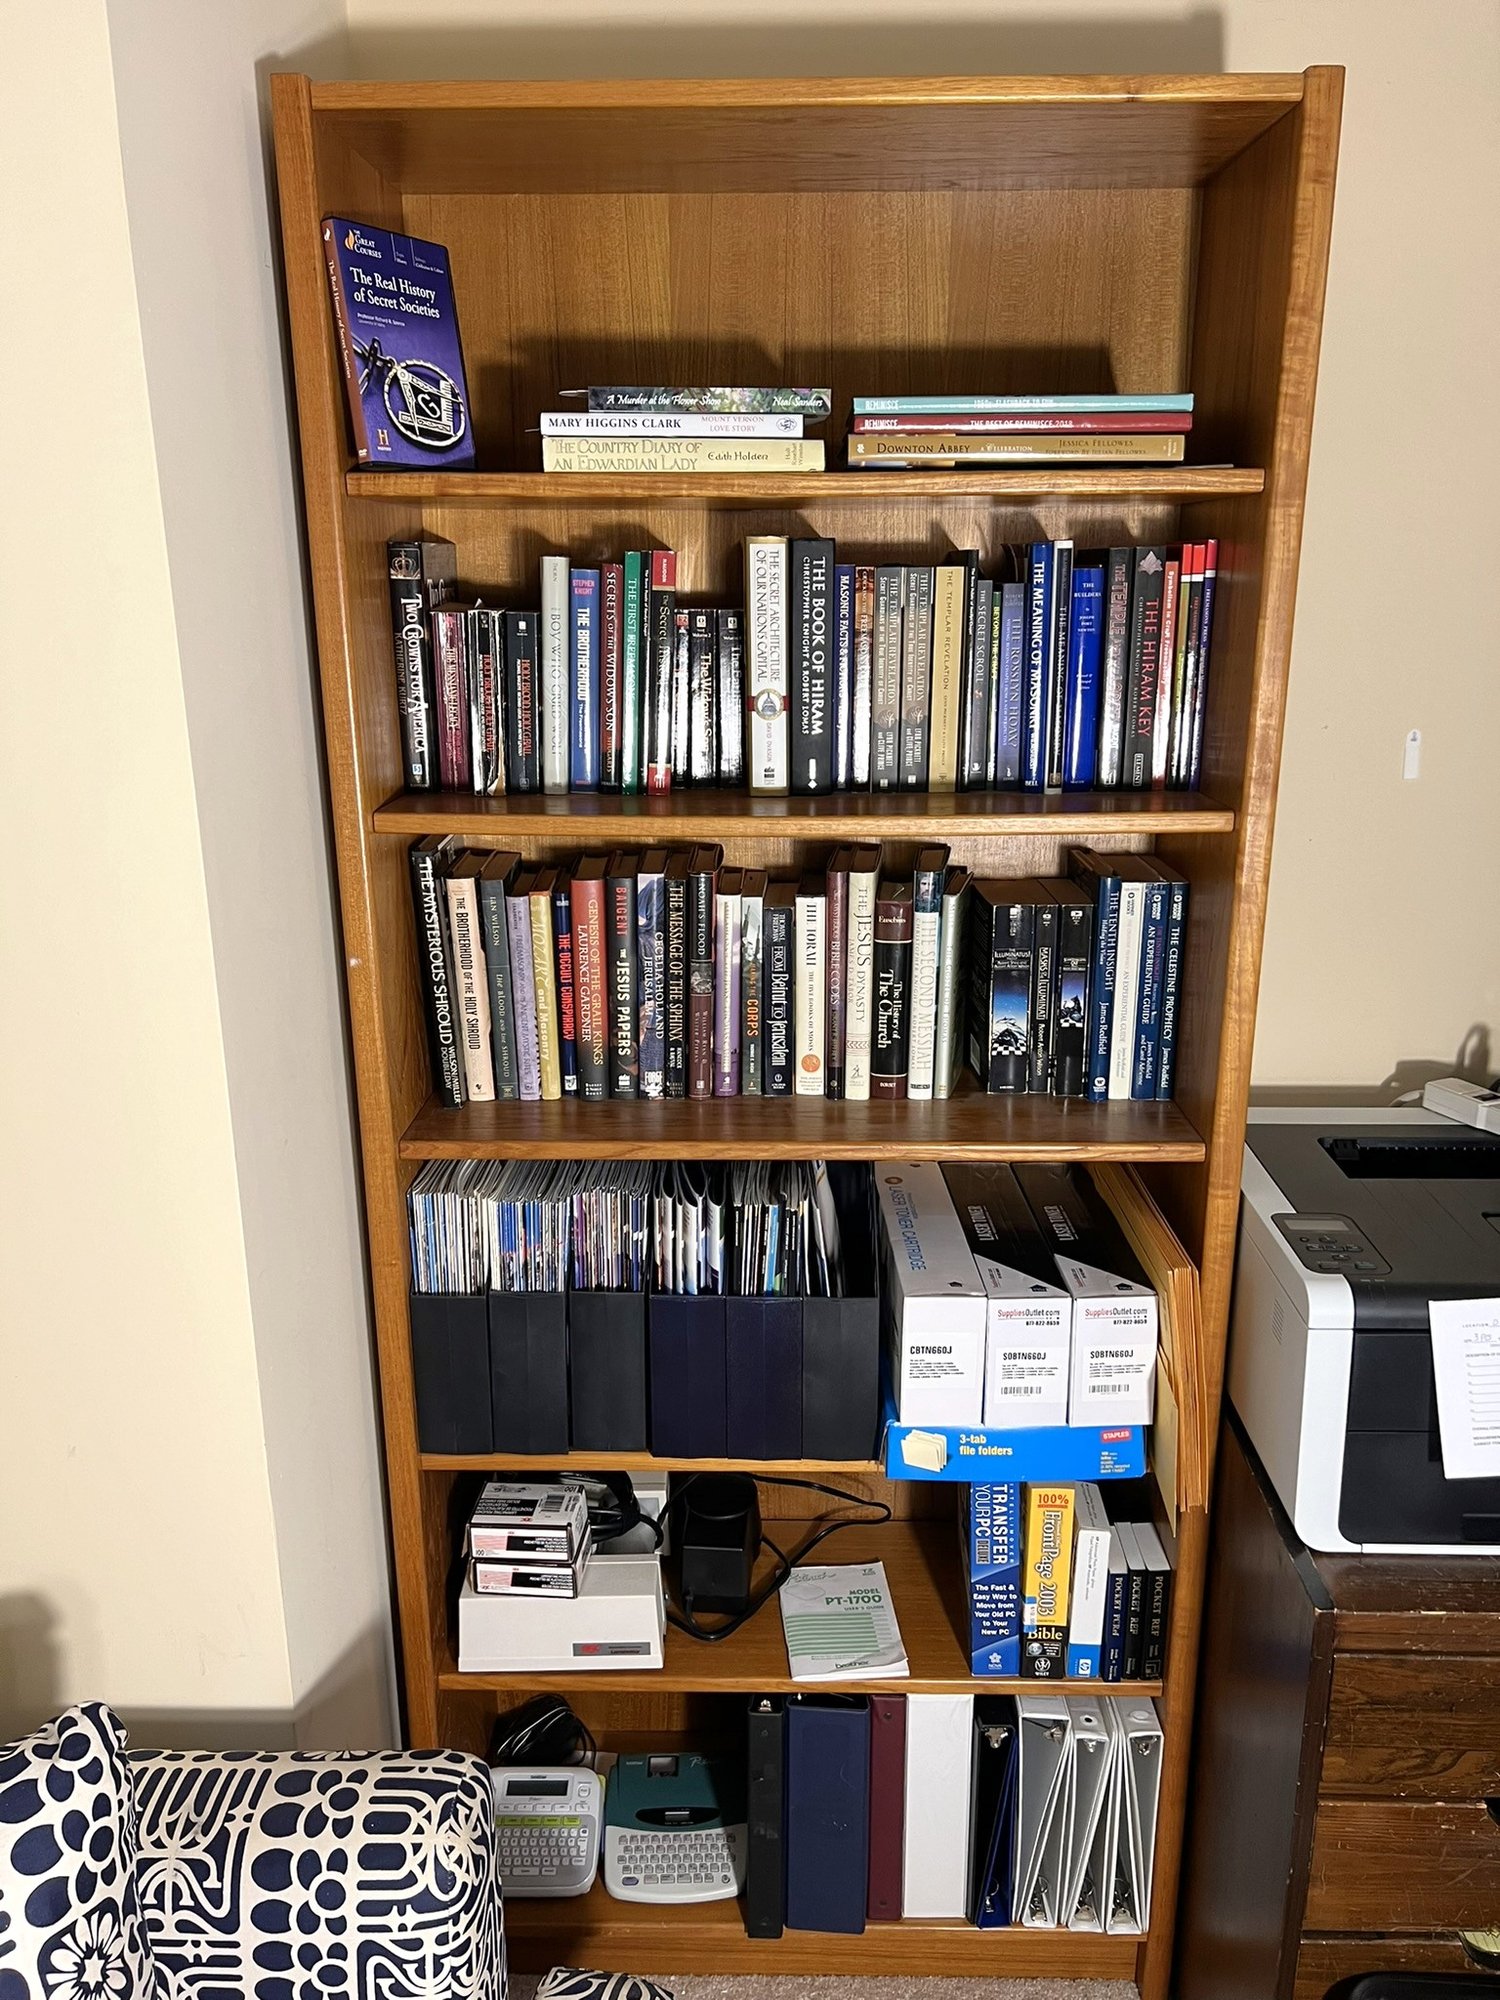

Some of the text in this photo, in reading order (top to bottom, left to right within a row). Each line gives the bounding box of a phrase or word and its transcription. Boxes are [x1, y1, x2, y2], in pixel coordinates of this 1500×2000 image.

[354, 244, 382, 259] COURSES
[355, 236, 375, 248] GREAT
[350, 267, 435, 303] The Real History
[354, 288, 440, 319] of Secret Societies
[549, 418, 682, 428] MARY HIGGINS CLARK
[865, 400, 899, 410] REMINISCE
[552, 439, 702, 454] THE COUNTRY DIARY OF
[552, 456, 697, 470] AN EDWARDIAN LADY
[708, 452, 768, 461] Edith Holden
[877, 442, 970, 454] DOWNTON ABBEY
[1059, 439, 1133, 447] JESSICA FELLOWES
[802, 556, 810, 620] CHRISTOPHER
[756, 550, 767, 682] OF OUR NATION'S CAPITAL
[769, 550, 780, 682] THE SECRET ARCHITECTURE
[977, 605, 986, 642] SECRET
[802, 623, 810, 658] KNIGHT
[811, 556, 825, 735] THE BOOK OF HIRAM
[887, 577, 898, 705] THE TEMPLAR REVELATION
[916, 573, 928, 702] THE TEMPLAR REVELATION
[394, 632, 407, 716] KATHERINE KURTZ
[943, 636, 951, 690] REVELATION
[975, 645, 985, 683] SCROLL
[1008, 617, 1020, 747] THE ROSSLYN HOAX?
[1138, 598, 1159, 737] THE HIRAM KEY
[802, 670, 810, 702] ROBERT
[801, 705, 810, 735] LOMAS
[616, 887, 628, 936] BAIGENT
[698, 883, 707, 919] NOAH'S
[455, 897, 481, 1050] THE BROTHERHOOD OF THE HOLY SHROUD
[668, 886, 683, 1041] THE MESSAGE OF THE SPHINX
[830, 941, 840, 1005] BIBLE CODES
[853, 886, 872, 1023] THE JESUS DYNASTY
[1098, 891, 1120, 1055] THE TENTH INSIGHT James Redfield
[1141, 925, 1156, 1025] AN EXPERIENTIAL GUIDE
[558, 933, 574, 1040] THE OCCULT CONSPIRACY
[577, 924, 591, 1042] LAURENCE GARDNER
[588, 899, 603, 1065] GENESIS OF THE GRAIL KINGS
[616, 960, 631, 1001] JESUS
[644, 956, 653, 1016] JERUSALEM
[916, 918, 936, 1070] THE SECOND MESSIAH
[1163, 927, 1180, 1041] THE CELESTINE PROPHECY
[746, 999, 758, 1036] CORPS
[766, 946, 789, 1066] FROM Beirut TO Jerusalem
[877, 969, 894, 1049] The Church
[892, 981, 903, 1039] The History of
[617, 1006, 631, 1056] PAPERS
[1160, 1047, 1171, 1088] James Redfield
[997, 1309, 1060, 1318] SuppliesOutlet.com
[1085, 1308, 1148, 1317] SuppliesOutlet.com
[910, 1346, 952, 1354] CBTN660J
[959, 1446, 1013, 1456] file folders
[960, 1434, 987, 1444] 3-tab
[1103, 1431, 1129, 1439] STAPLES
[1038, 1494, 1069, 1504] 100%
[993, 1484, 1008, 1564] TRANSFER
[1035, 1511, 1063, 1616] FrontPage 2003
[826, 1595, 882, 1605] PT-1700
[1112, 1577, 1123, 1637] POCKET PCRef
[1130, 1576, 1142, 1634] POCKET REF
[1153, 1576, 1164, 1613] POCKET
[1028, 1627, 1063, 1640] Bible
[1150, 1619, 1160, 1637] REF
[835, 1661, 869, 1669] brother
